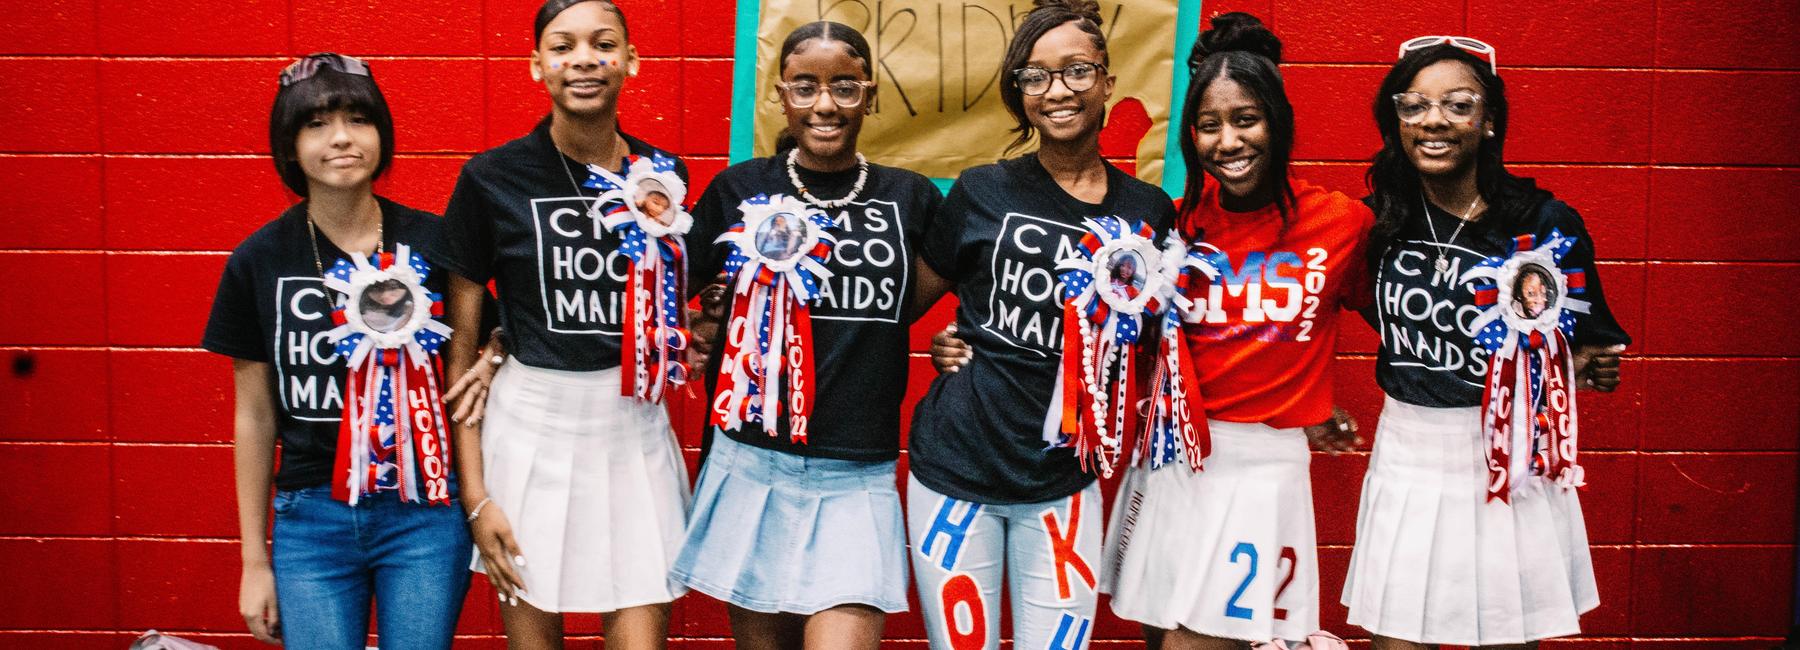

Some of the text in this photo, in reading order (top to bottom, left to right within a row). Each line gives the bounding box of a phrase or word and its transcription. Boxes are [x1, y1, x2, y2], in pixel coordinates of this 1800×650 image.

[824, 238, 896, 268] CO
[554, 289, 628, 325] MAI
[1295, 247, 1329, 342] 2022
[1385, 282, 1485, 338] HOCO
[998, 300, 1064, 350] MAI
[408, 387, 449, 500] HOCO 22
[1225, 541, 1297, 621] 22
